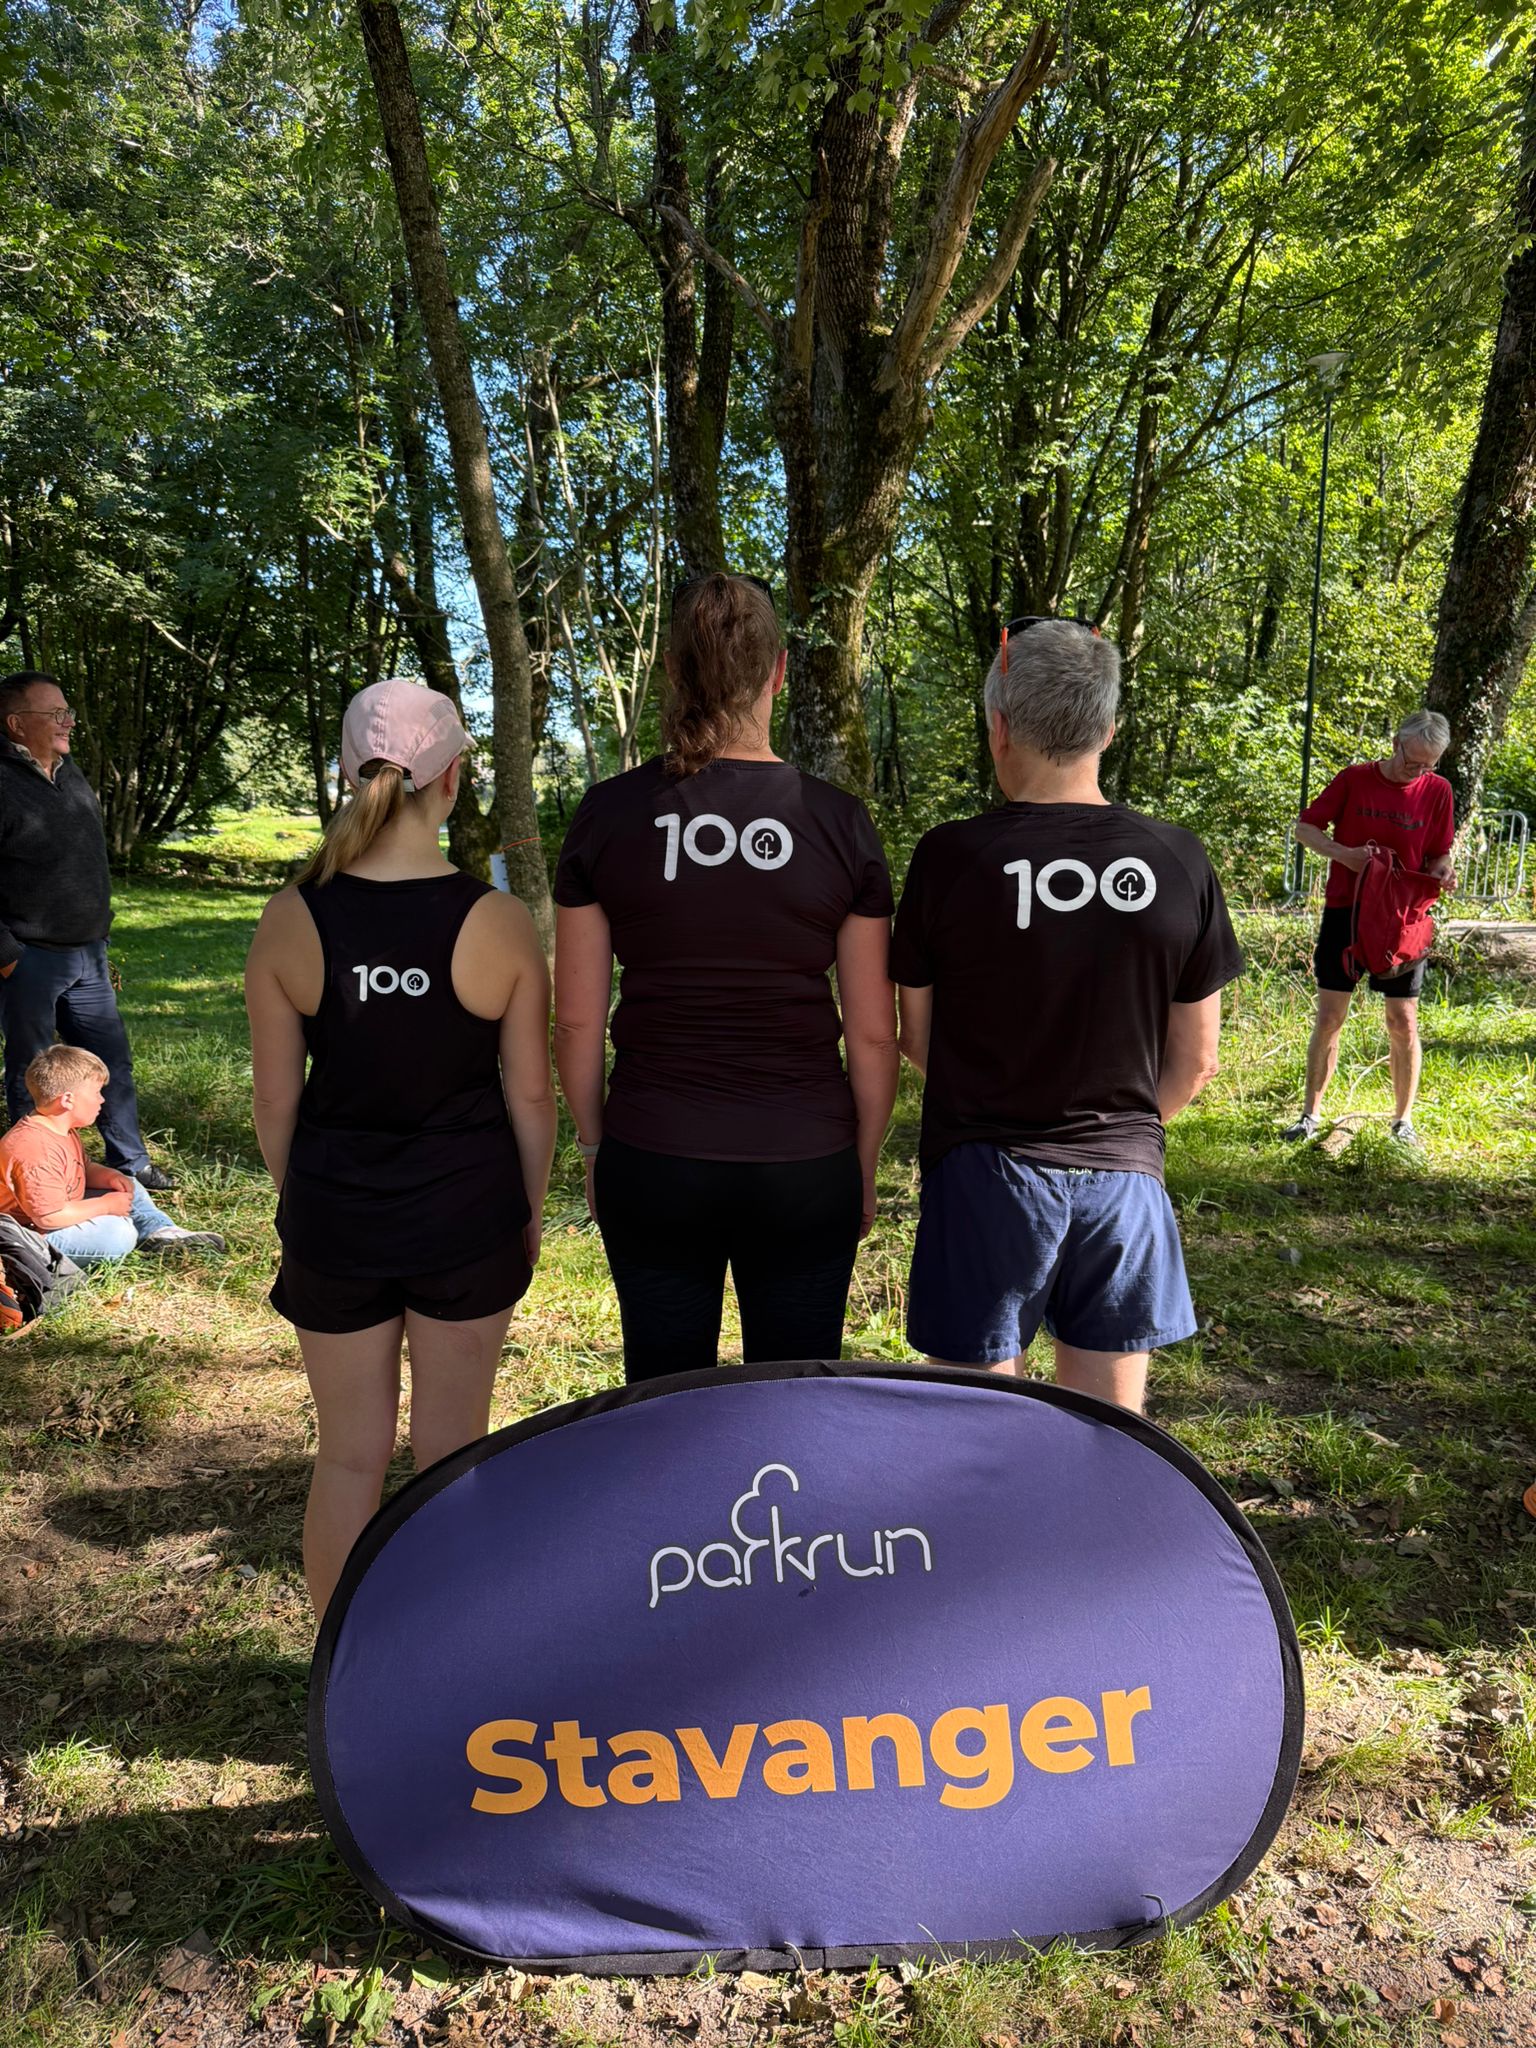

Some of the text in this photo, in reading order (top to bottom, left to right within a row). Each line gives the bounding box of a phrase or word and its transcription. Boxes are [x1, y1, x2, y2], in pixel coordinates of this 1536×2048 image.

[654, 813, 794, 881] 100
[1003, 856, 1157, 930] 100
[352, 964, 431, 1002] 100
[648, 1504, 932, 1609] parkrun
[465, 1686, 1151, 1815] Stavanger
